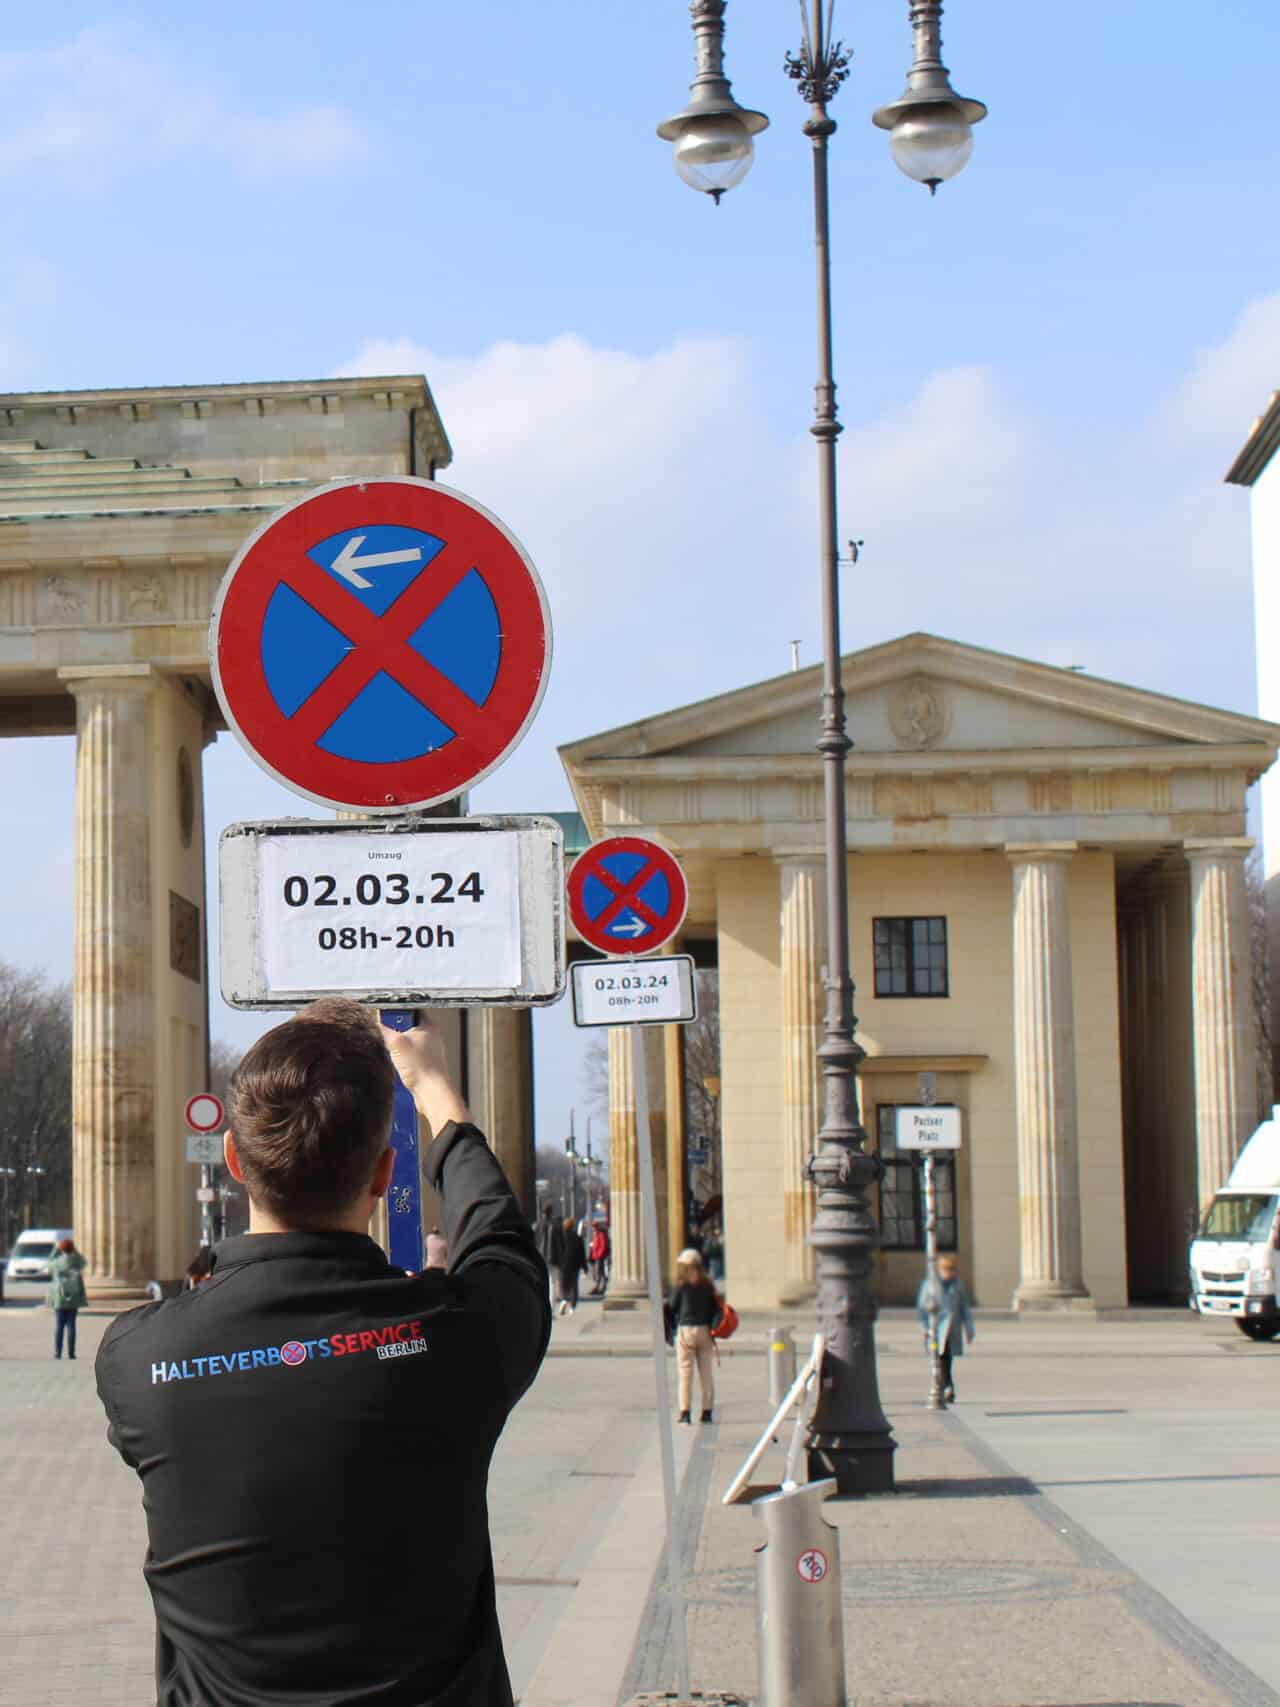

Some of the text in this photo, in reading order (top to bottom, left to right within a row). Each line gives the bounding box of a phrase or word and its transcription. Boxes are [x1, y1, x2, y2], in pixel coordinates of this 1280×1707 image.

[368, 851, 402, 861] Umzug
[283, 871, 485, 907] 02.03.24
[318, 924, 455, 950] 08h-20h
[594, 975, 669, 991] 02.03.24
[608, 994, 659, 1007] 08h-20h
[376, 1338, 428, 1361] BERLIN
